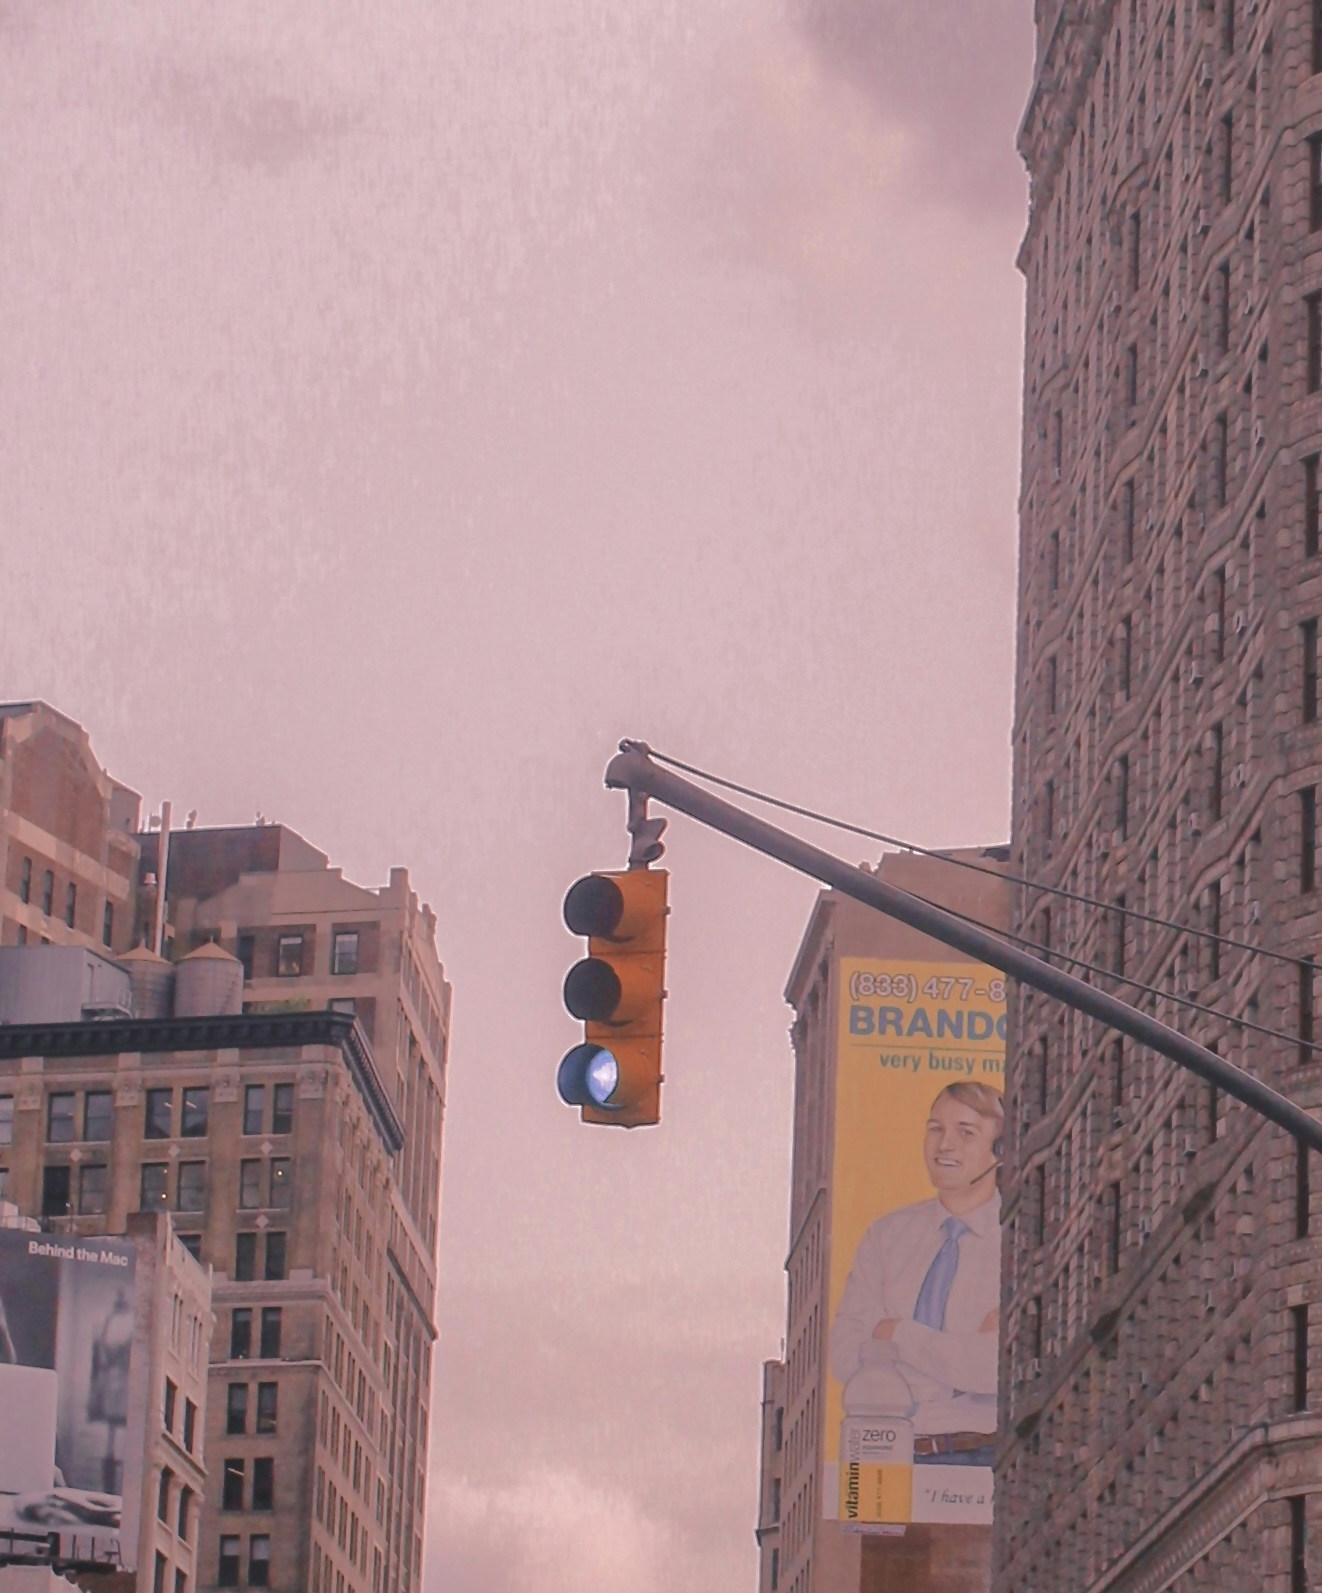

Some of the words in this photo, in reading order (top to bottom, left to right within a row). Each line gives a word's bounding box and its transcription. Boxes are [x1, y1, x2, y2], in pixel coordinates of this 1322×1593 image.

[850, 971, 918, 1003] (833)
[922, 976, 1006, 1003] 477-8
[879, 1053, 921, 1072] very
[928, 1051, 975, 1075] busy
[982, 1057, 1006, 1073] m
[28, 1240, 75, 1259] Behind
[76, 1248, 98, 1262] the
[100, 1250, 129, 1266] Mac
[862, 1429, 897, 1442] zero
[941, 1488, 973, 1504] have
[976, 1493, 985, 1504] a
